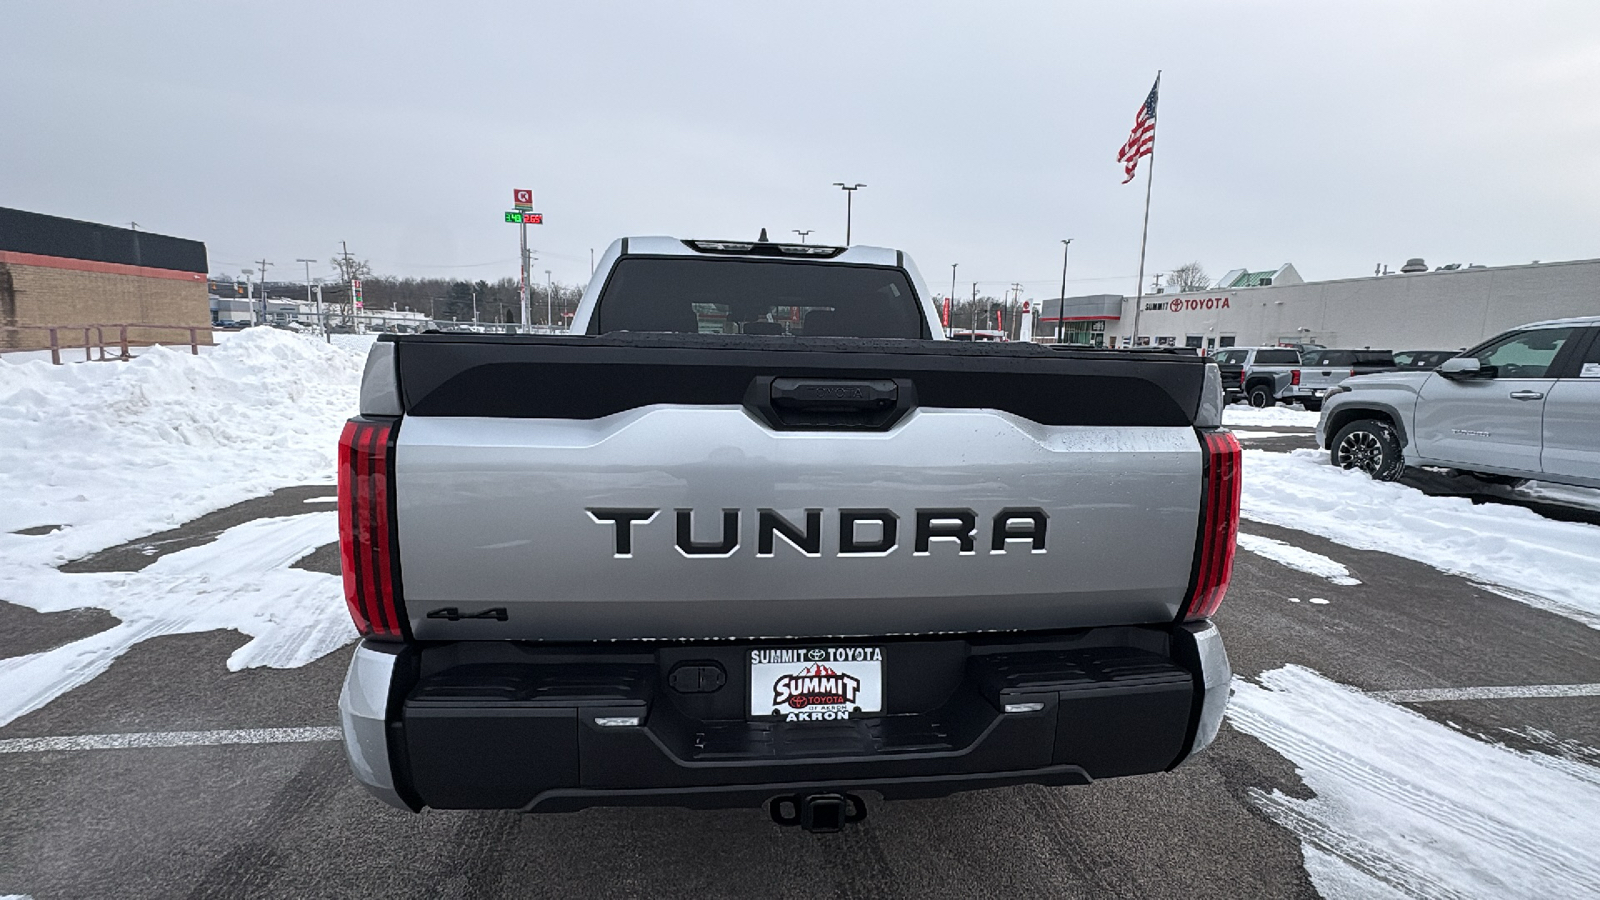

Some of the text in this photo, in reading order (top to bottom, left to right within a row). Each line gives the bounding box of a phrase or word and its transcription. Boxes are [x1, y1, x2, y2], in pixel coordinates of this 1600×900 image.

[1145, 298, 1230, 311] SUMMIT TOYOTA
[807, 387, 863, 399] TOYOTA
[585, 507, 1050, 558] TUNDRA
[751, 648, 882, 663] SUMMIT TOYOTA
[775, 677, 858, 702] SUMMIT
[808, 696, 844, 704] TOYOTA
[786, 711, 849, 722] AKRON
